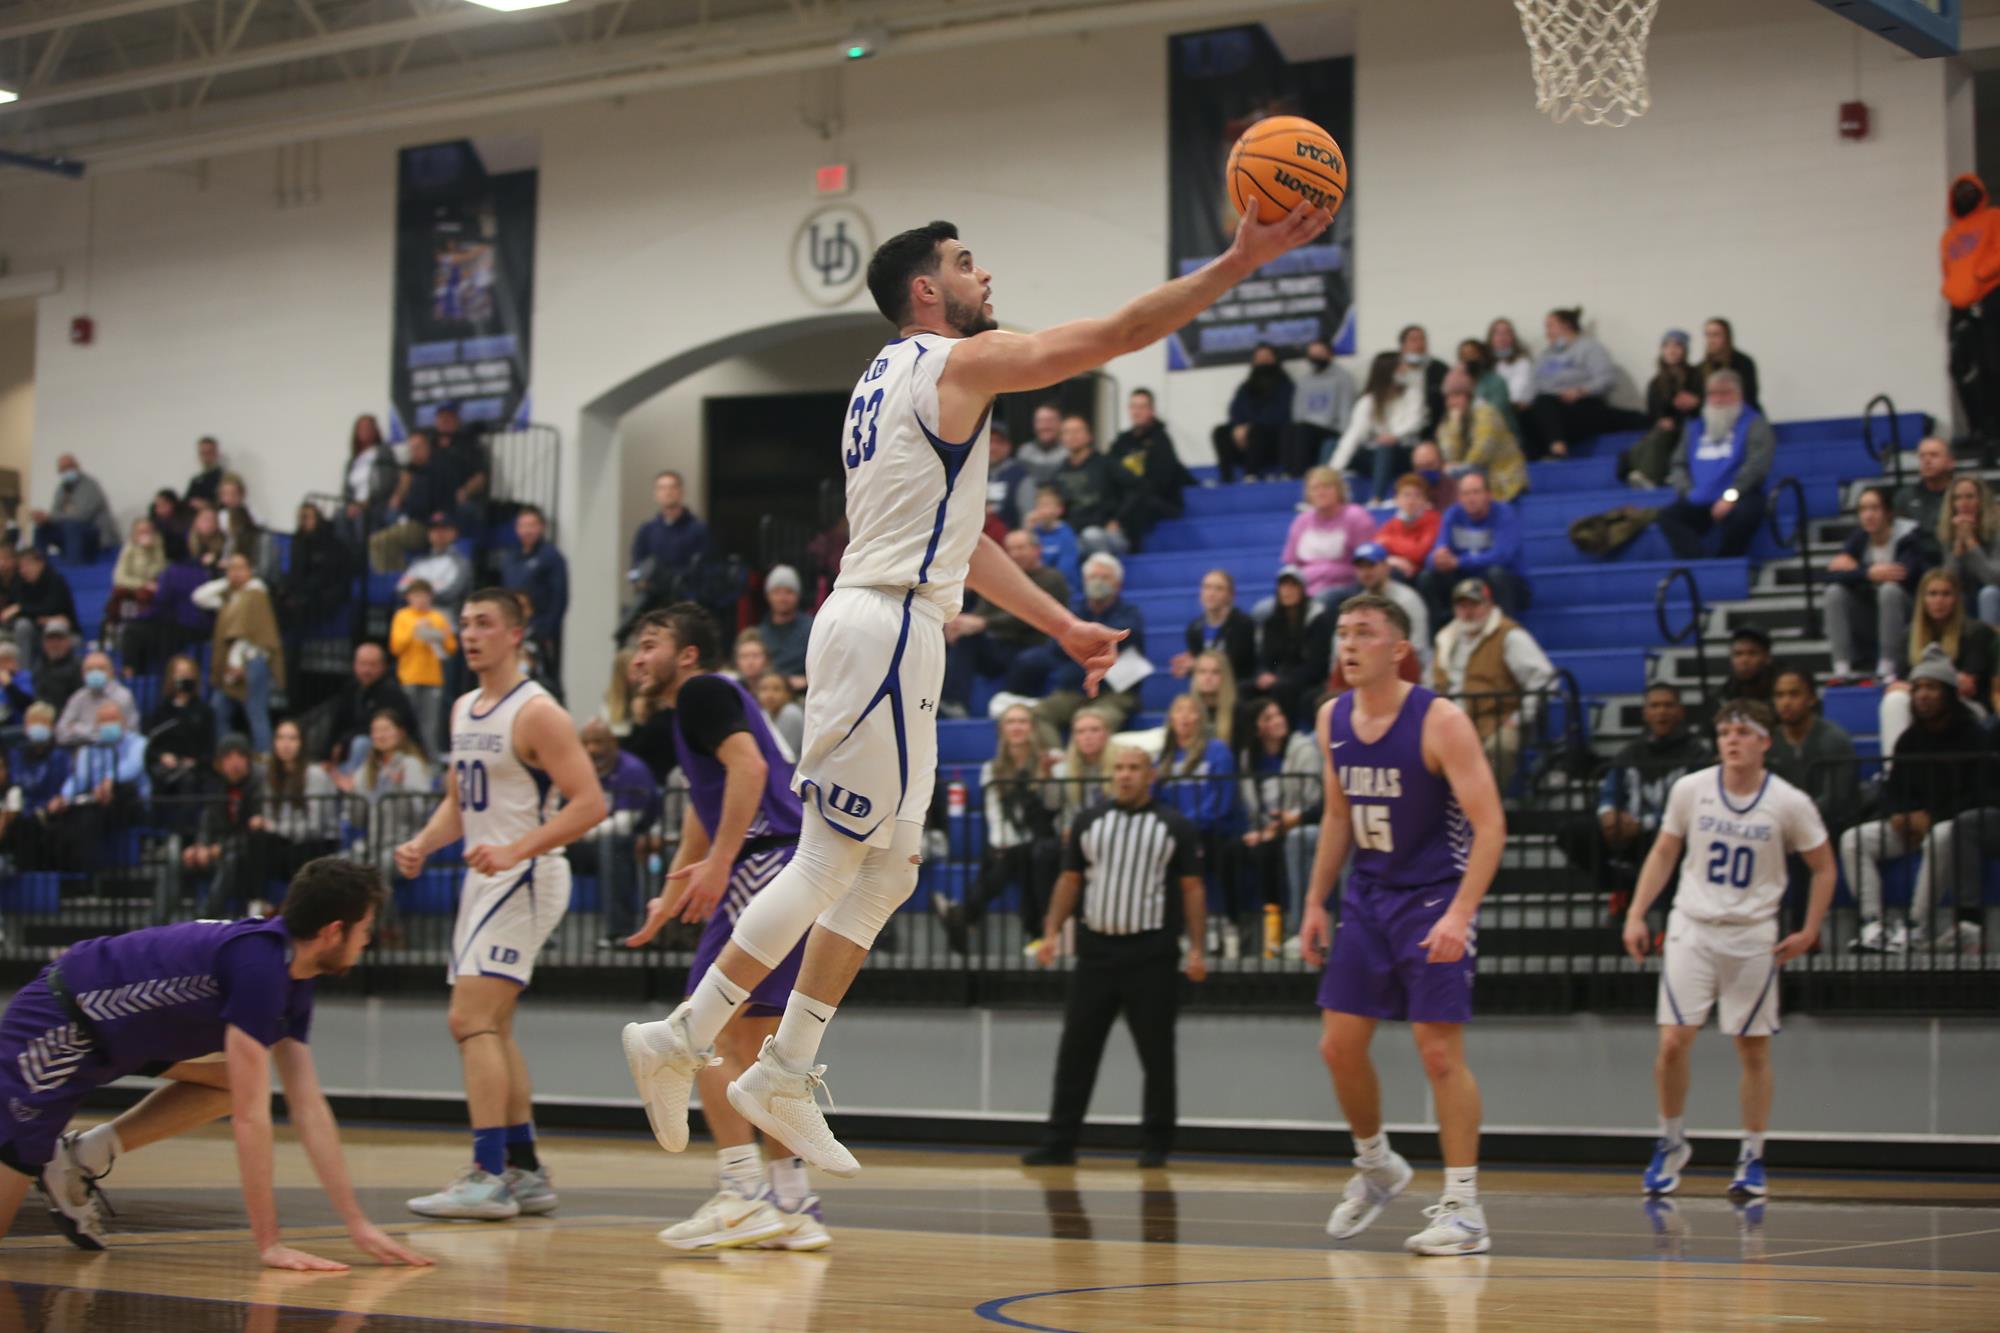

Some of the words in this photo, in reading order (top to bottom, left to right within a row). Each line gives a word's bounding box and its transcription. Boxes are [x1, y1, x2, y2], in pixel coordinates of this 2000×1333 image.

[1296, 141, 1341, 174] NCAA
[846, 388, 884, 469] 33
[451, 733, 504, 752] PARTANS
[1339, 766, 1402, 798] LORAS
[1351, 804, 1394, 853] 15
[1698, 816, 1771, 842] SPARTANS
[1707, 840, 1755, 889] 20
